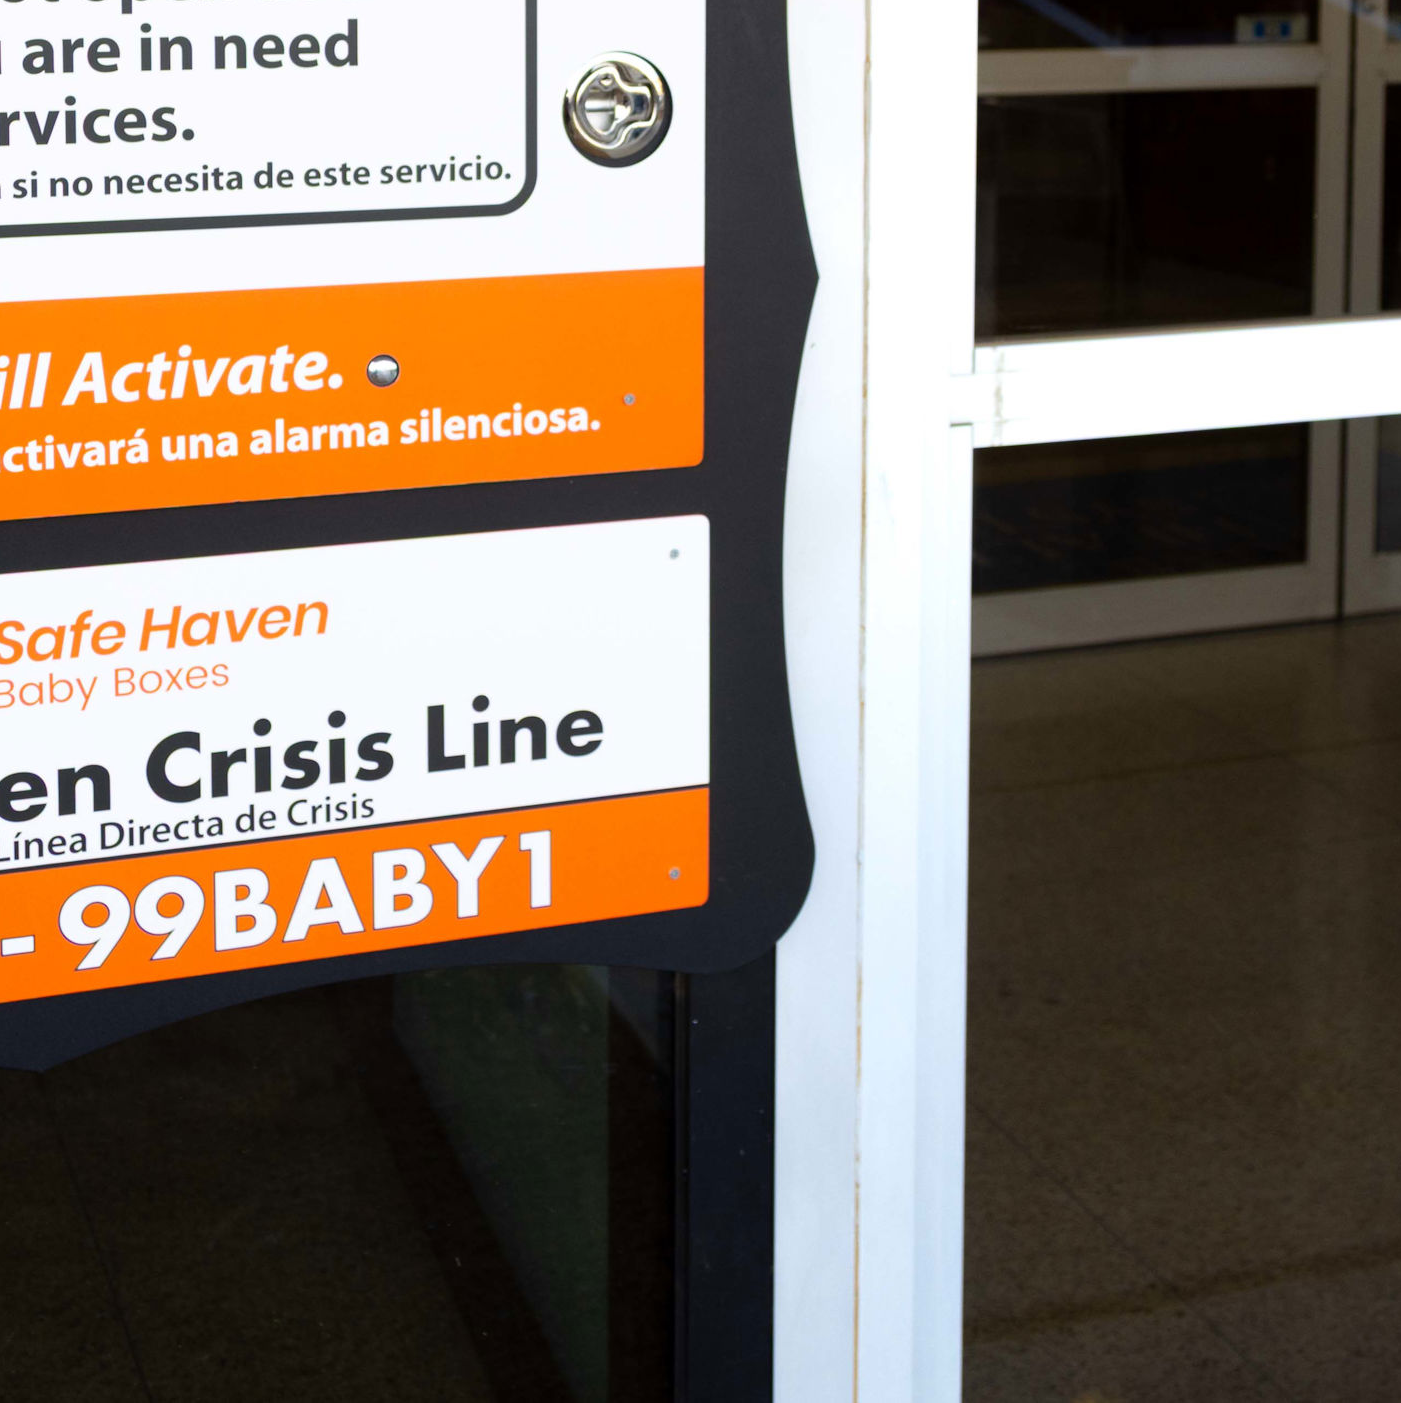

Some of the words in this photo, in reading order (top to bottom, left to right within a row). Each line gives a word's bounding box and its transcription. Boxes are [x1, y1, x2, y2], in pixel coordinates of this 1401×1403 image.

[23, 38, 120, 74] are
[141, 24, 192, 71] in
[215, 19, 358, 69] need
[62, 345, 343, 405] Activate.
[162, 432, 238, 461] una
[250, 419, 388, 455] alarma
[401, 403, 600, 444] silenciosa.
[139, 601, 328, 652] Haven
[115, 664, 229, 696] Boxes
[147, 711, 393, 803] Crisis
[428, 695, 603, 772] Line
[101, 815, 223, 849] Directa
[236, 805, 276, 832] de
[288, 799, 374, 826] Crisis
[59, 830, 551, 970] 99BABY1
